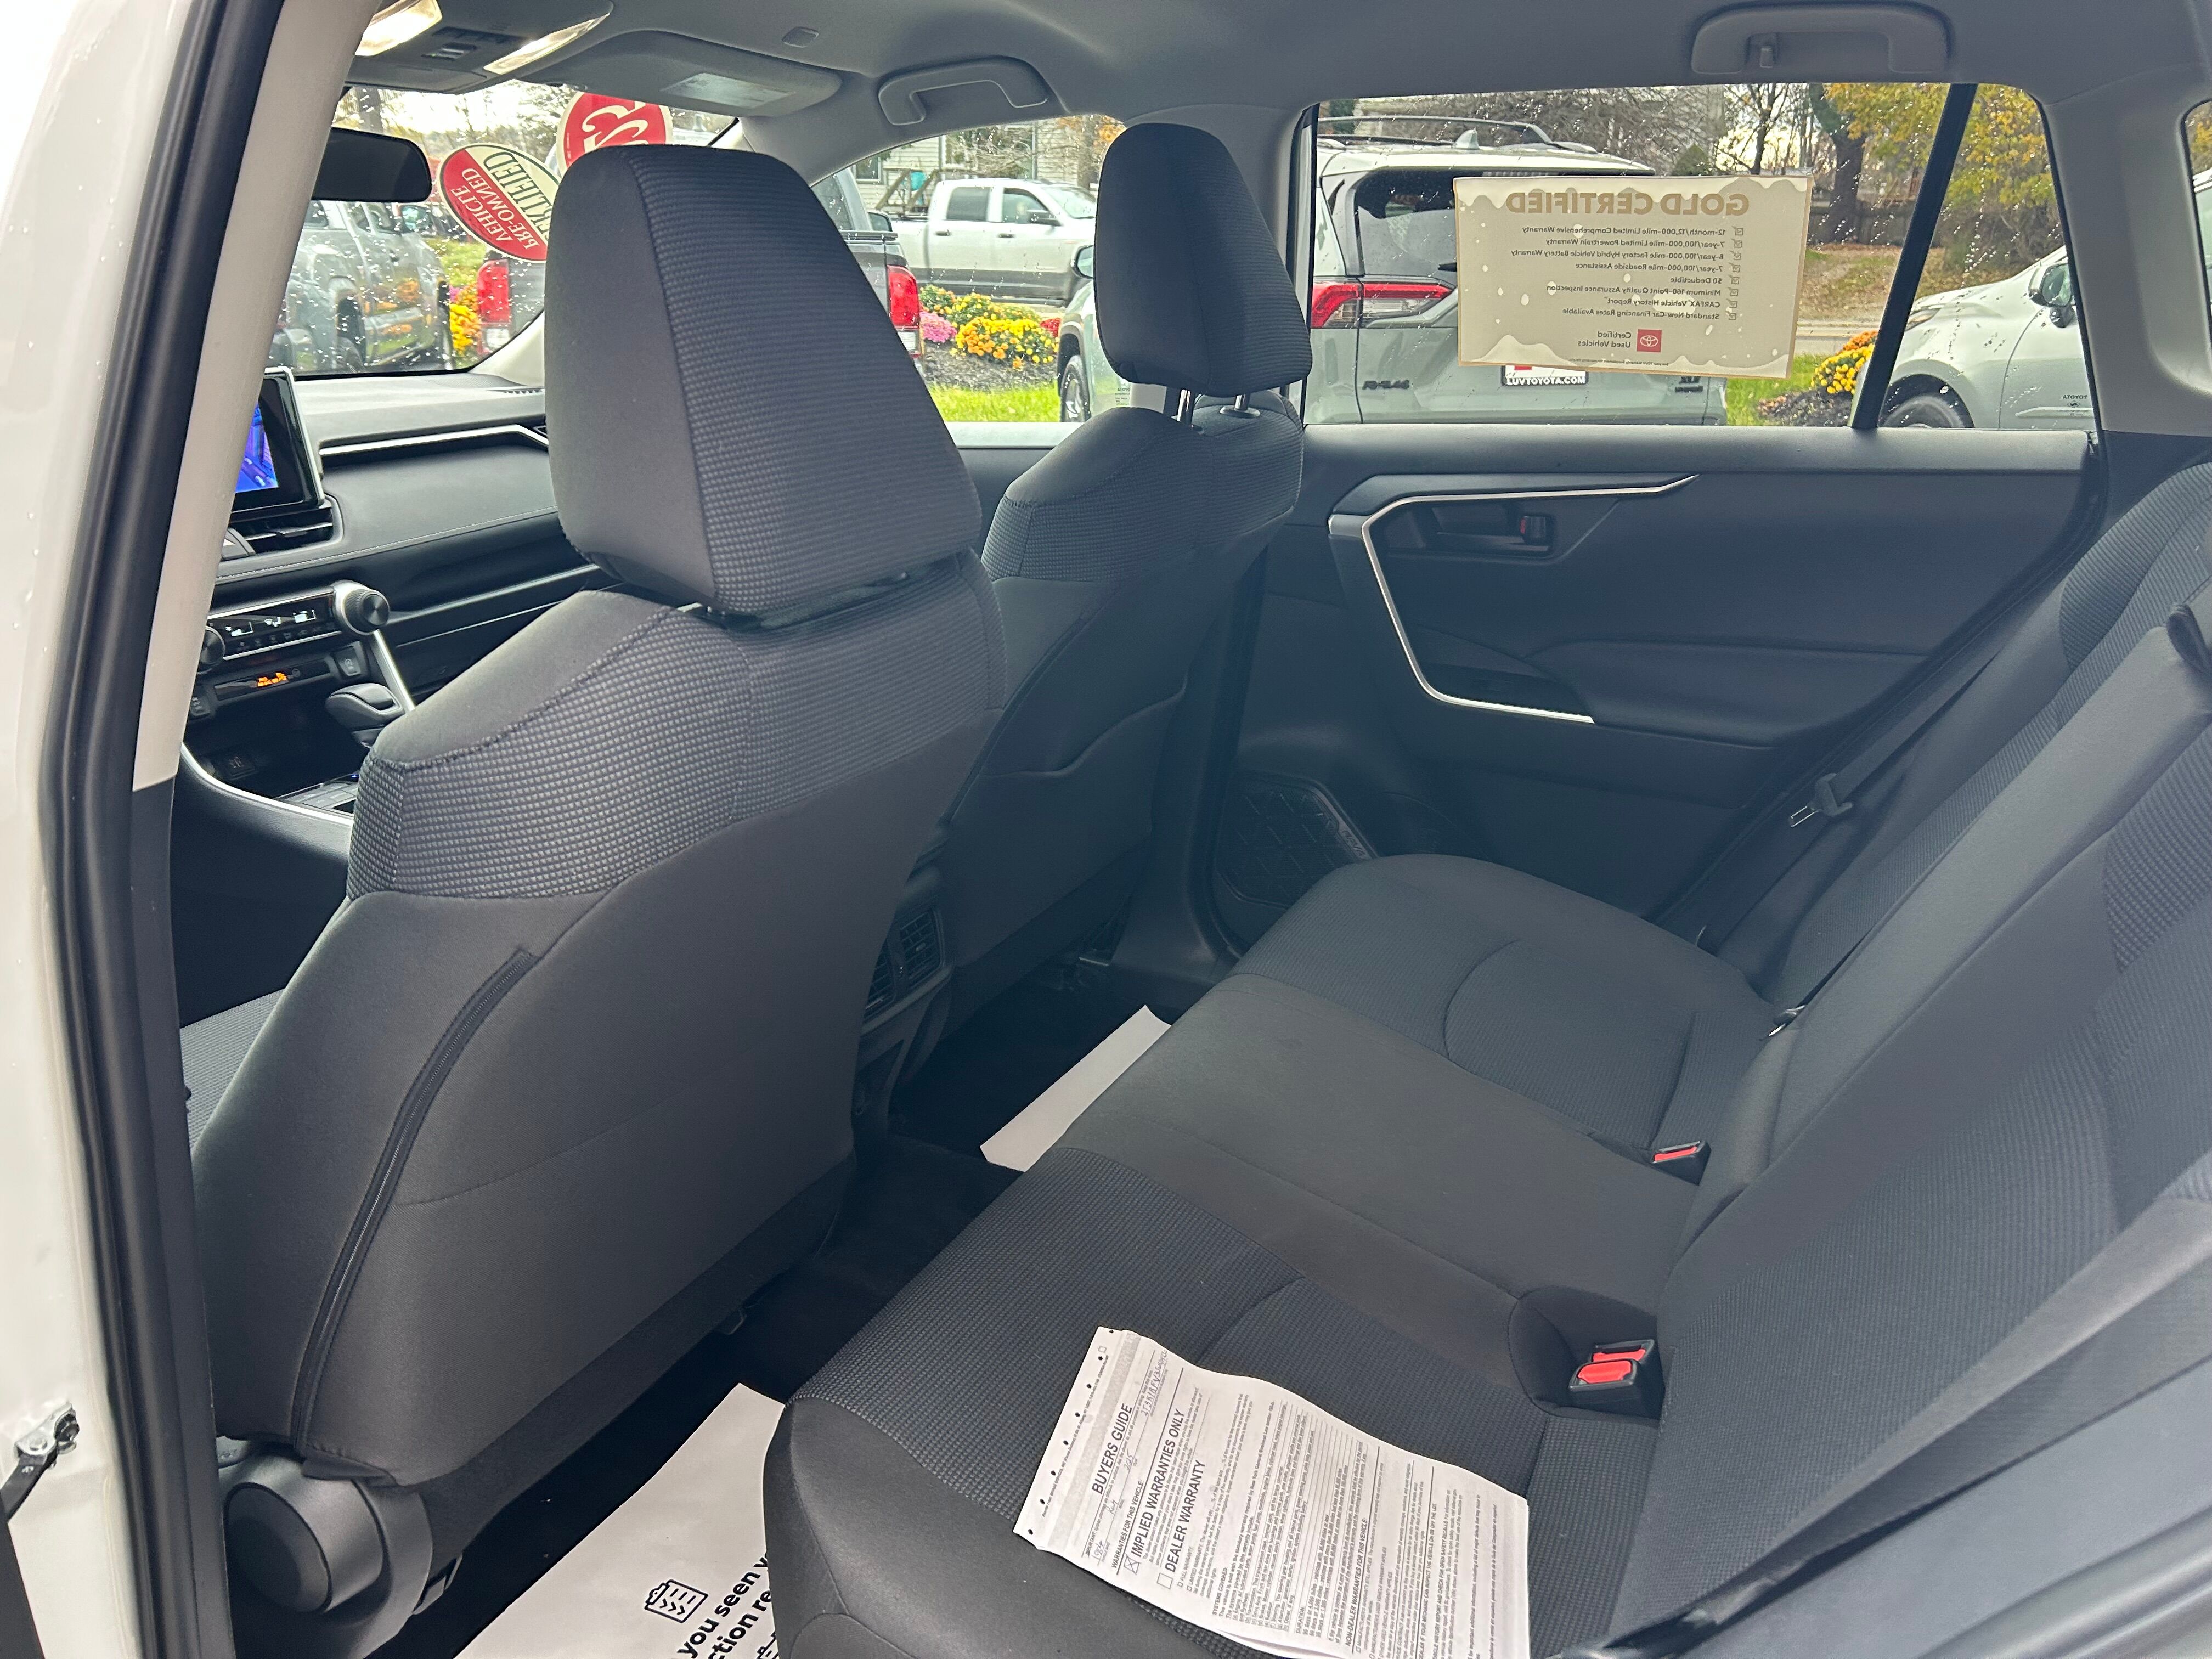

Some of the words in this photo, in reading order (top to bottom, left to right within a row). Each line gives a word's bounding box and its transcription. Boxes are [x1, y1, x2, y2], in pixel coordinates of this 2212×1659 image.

[1506, 376, 1585, 385] LUVTOYOTA.COM
[1091, 1442, 1118, 1494] BUYERS
[1110, 1403, 1132, 1441] GUIDE
[1131, 1510, 1153, 1558] IMPLIED
[1145, 1438, 1175, 1510] WARRANTIES
[1167, 1409, 1184, 1438] ONLY
[1111, 1532, 1127, 1568] WARRANTIES
[1122, 1519, 1131, 1532] FOR
[1127, 1505, 1135, 1519] THIS
[1165, 1524, 1187, 1573] DEALER
[1178, 1459, 1205, 1523] WARRANTY
[676, 1618, 719, 1659] you
[714, 1572, 760, 1617] seen
[1212, 1592, 1221, 1615] SYSTEMS
[1345, 1605, 1356, 1646] NON-DEALER
[1351, 1566, 1361, 1605] WARRANTIES
